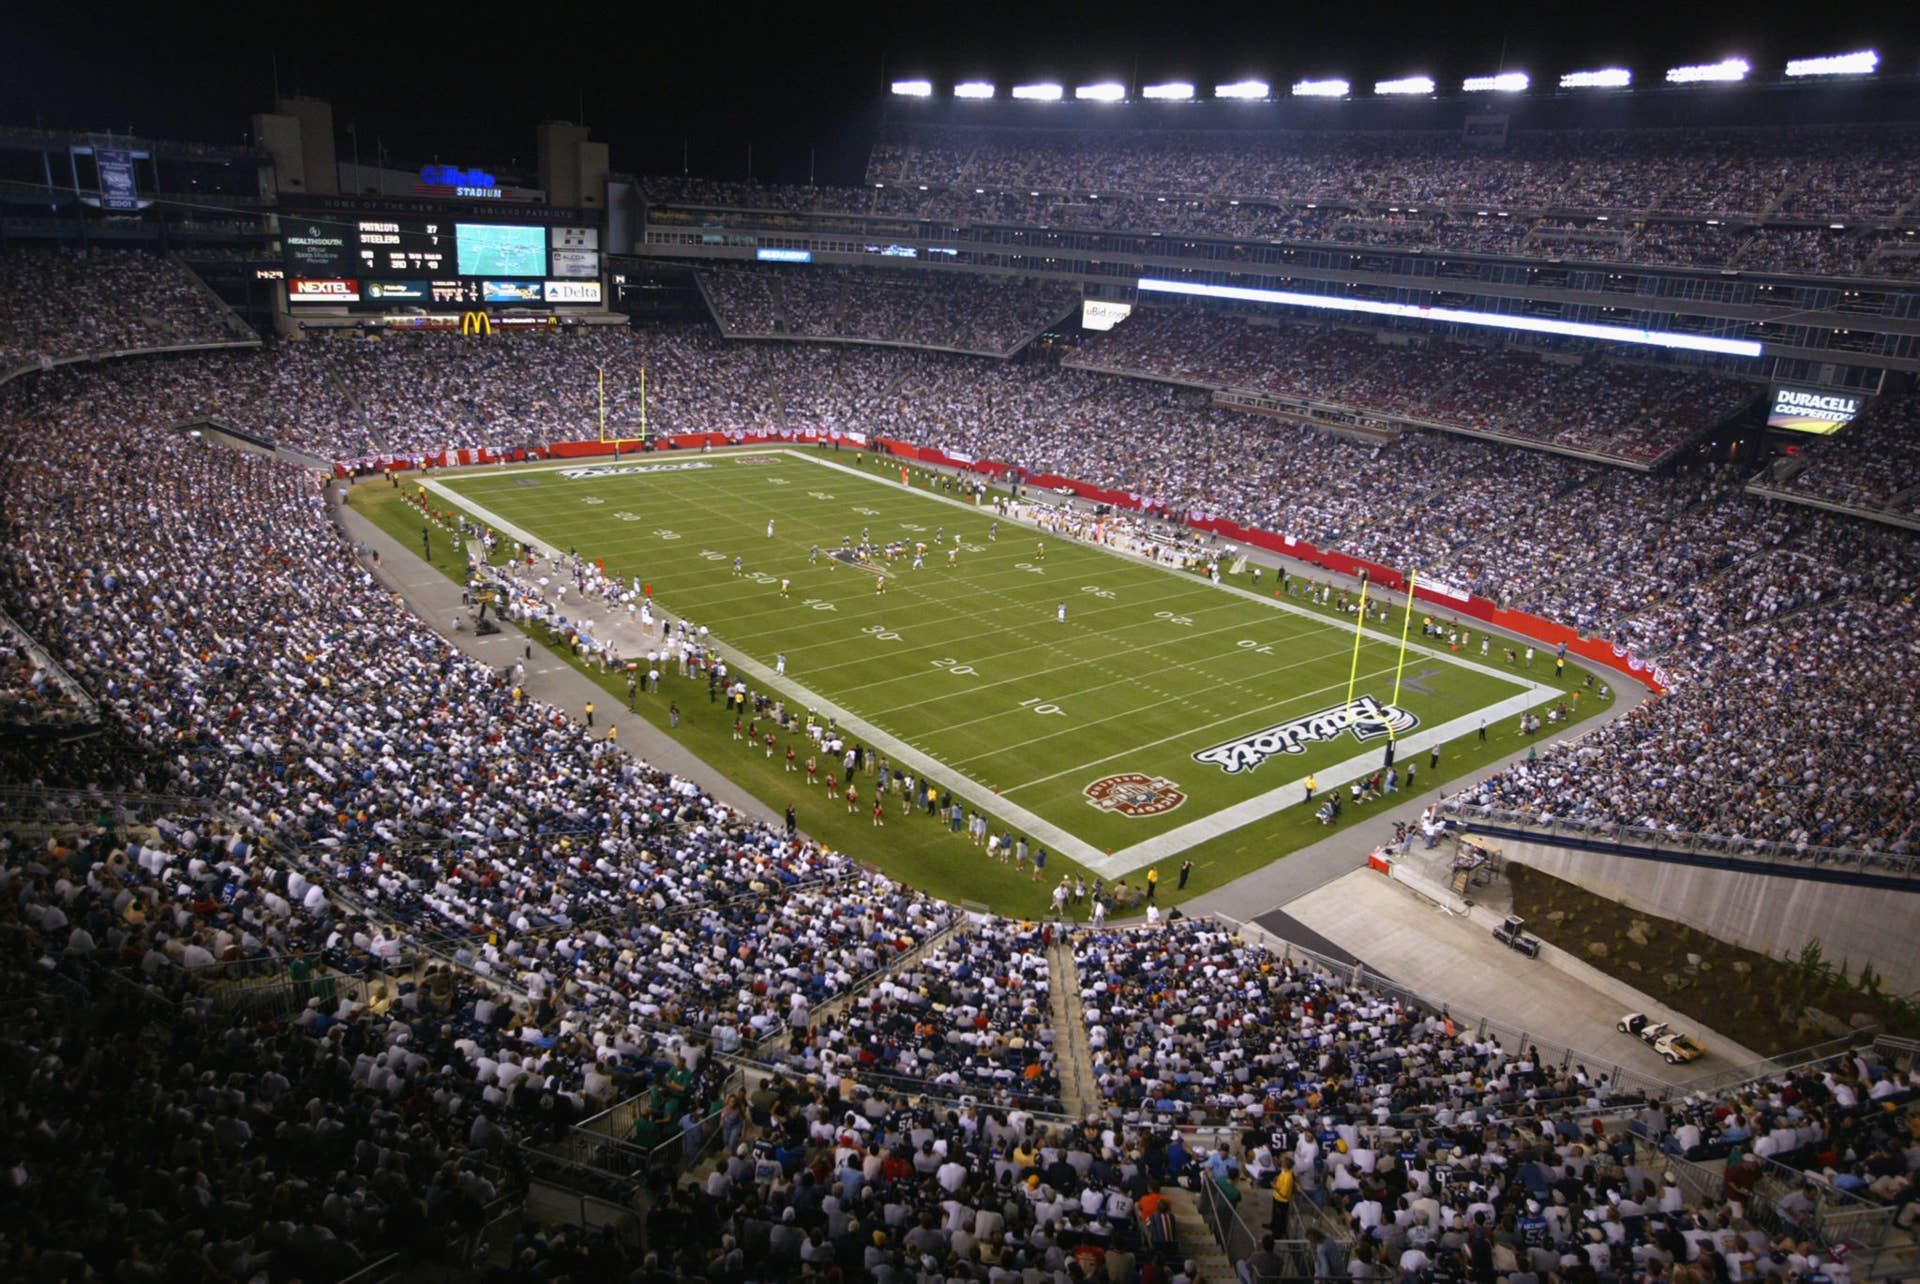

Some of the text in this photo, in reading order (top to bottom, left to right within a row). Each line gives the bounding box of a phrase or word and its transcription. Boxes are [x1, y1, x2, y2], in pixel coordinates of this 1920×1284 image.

[422, 165, 495, 189] Gillette
[456, 187, 502, 198] STADIUM
[359, 222, 400, 233] PATRIOTS
[288, 237, 343, 246] HEALTHSOUTH
[360, 234, 401, 245] STEELERS
[297, 281, 351, 293] NEXTEL
[563, 285, 598, 299] Delta
[1777, 389, 1857, 413] DURACELL
[652, 528, 681, 540] 30
[698, 549, 727, 561] 40
[743, 570, 777, 584] 50
[801, 598, 837, 613] 40
[1153, 611, 1193, 627] 20
[860, 624, 900, 642] 30
[1236, 639, 1275, 655] 10
[930, 657, 976, 677] 20
[1017, 697, 1062, 716] 10
[1193, 695, 1405, 774] Patriots
[1271, 1132, 1288, 1150] 51
[1116, 1199, 1127, 1211] 12
